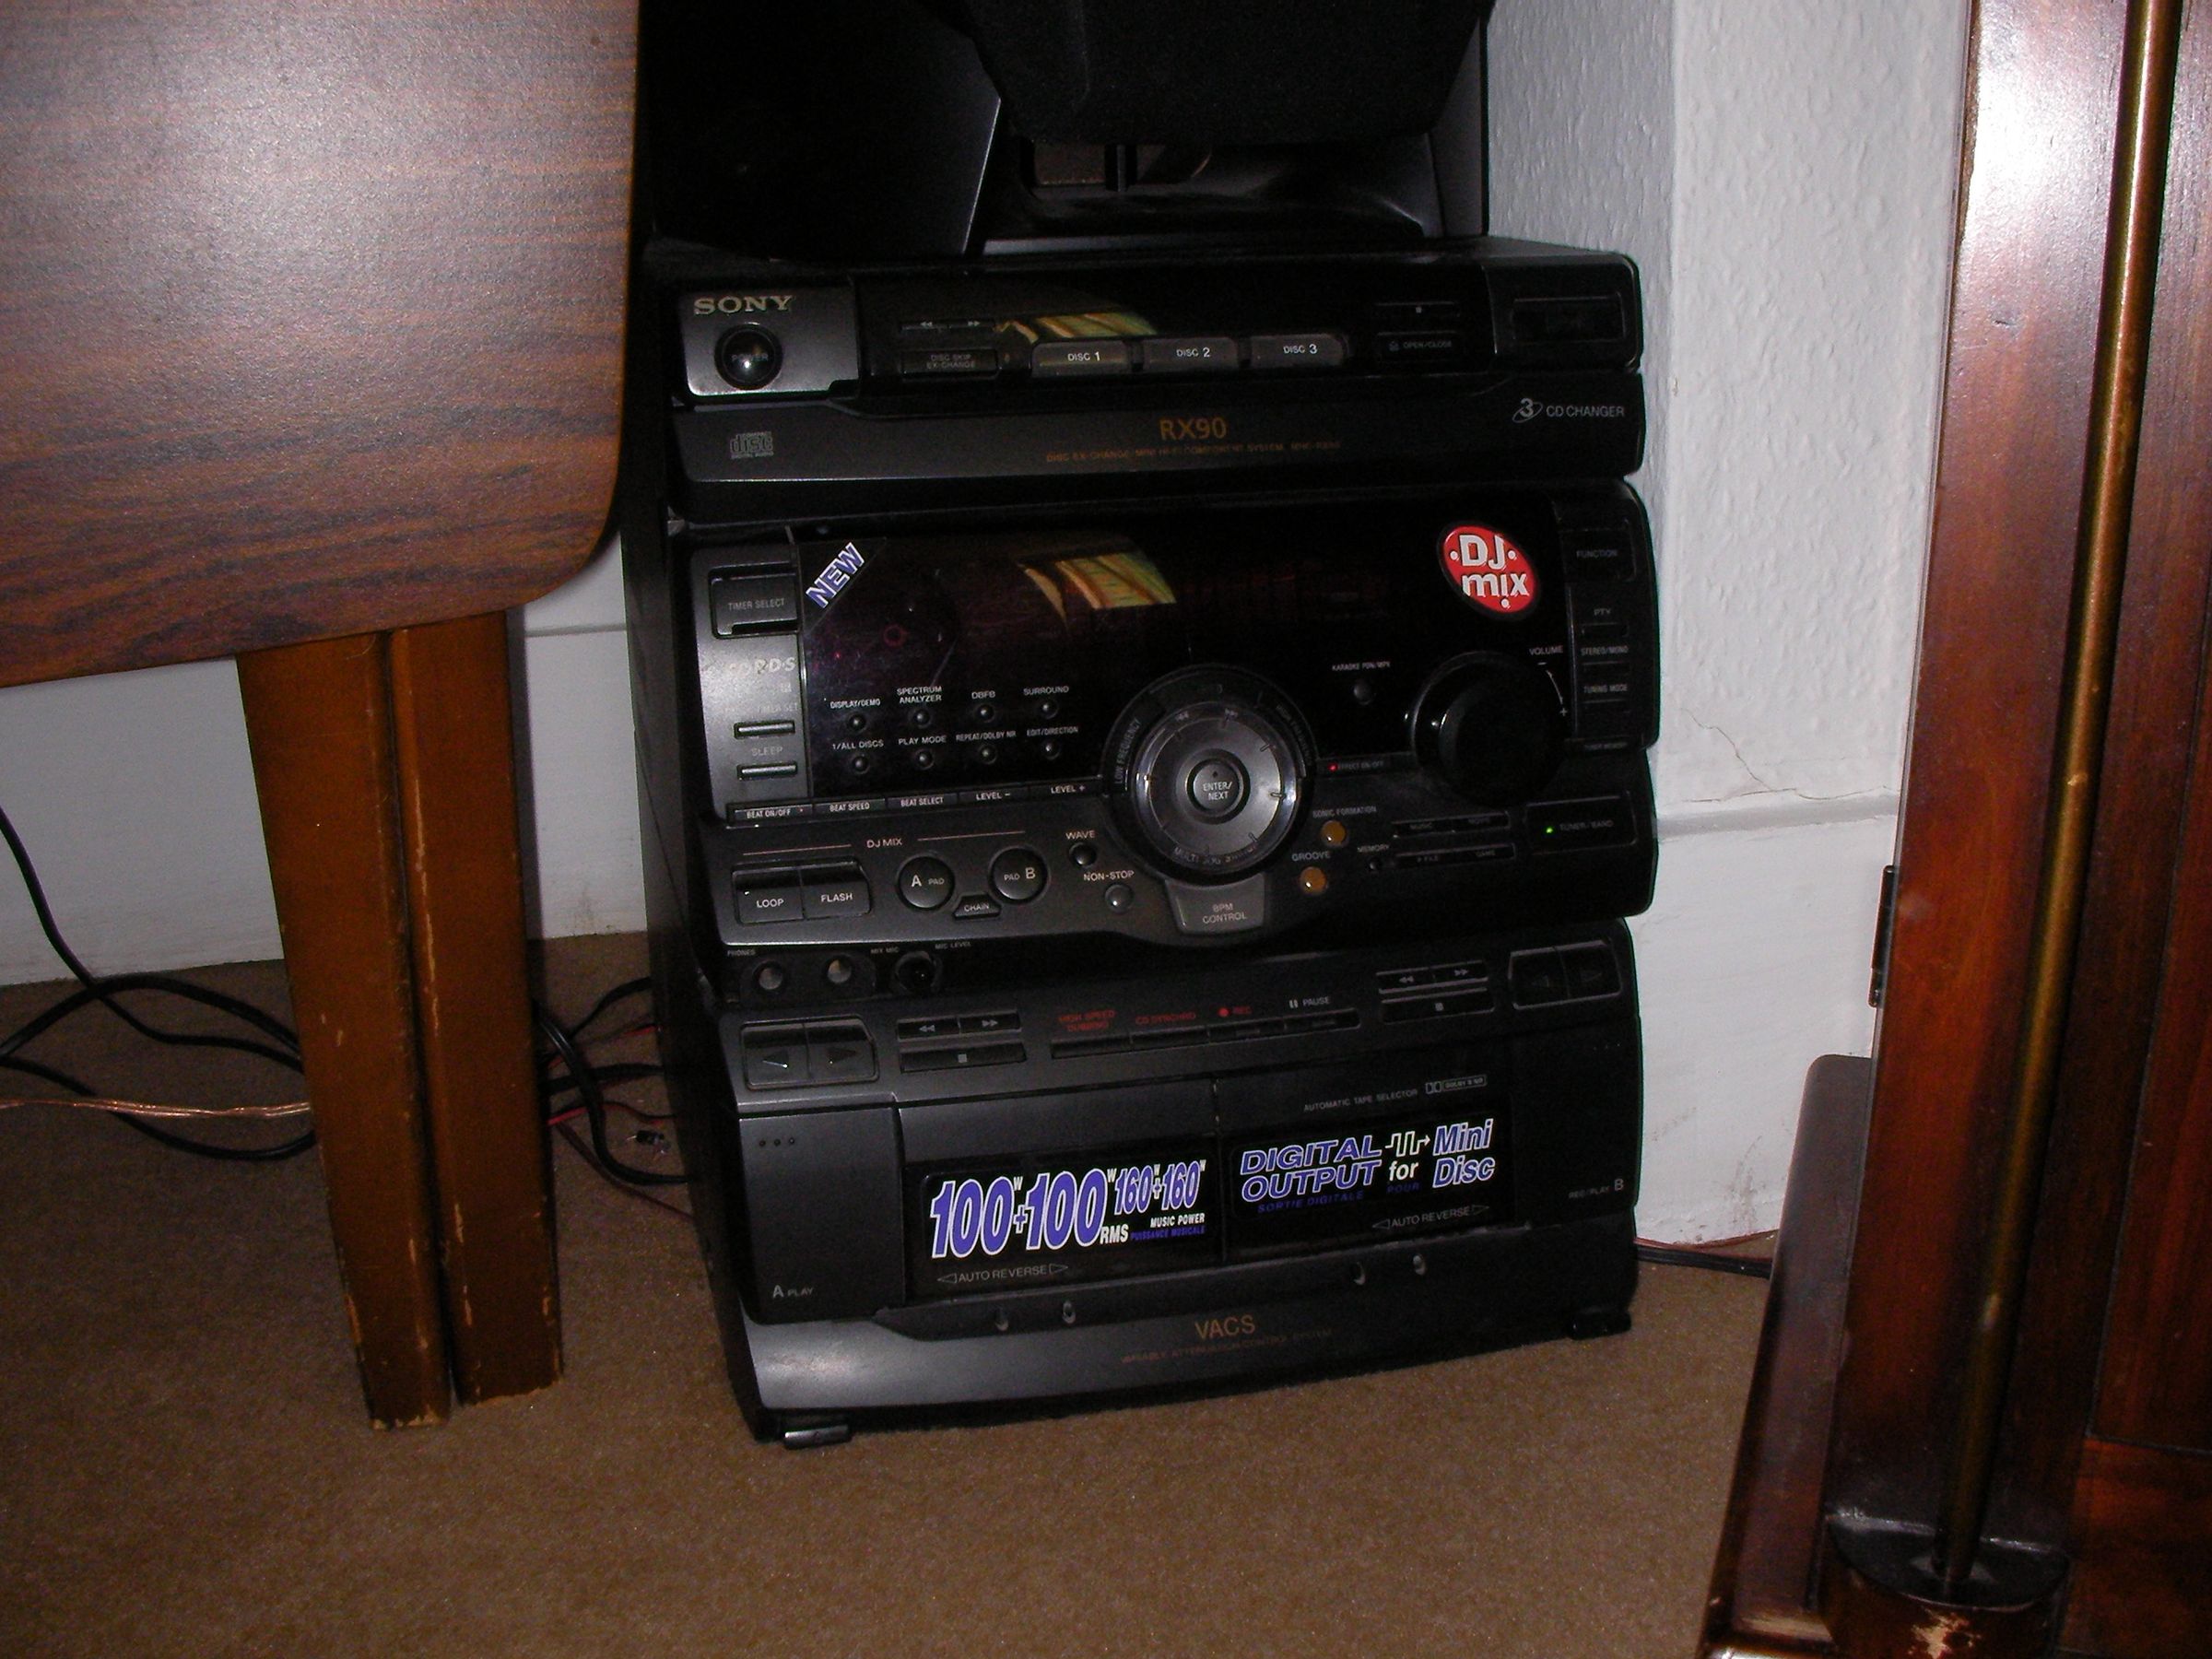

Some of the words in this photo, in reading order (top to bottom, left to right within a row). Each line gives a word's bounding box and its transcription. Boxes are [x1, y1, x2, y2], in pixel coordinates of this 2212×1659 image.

[693, 295, 794, 315] SONY
[1176, 348, 1199, 359] DISC
[1203, 347, 1211, 359] 2
[1282, 345, 1306, 355] DISC
[1309, 343, 1318, 355] 3
[1067, 353, 1091, 362] DISC
[1094, 351, 1101, 362] 1
[1519, 397, 1535, 418] 3
[1546, 405, 1565, 418] CD
[1566, 405, 1626, 418] CHANGER
[1159, 416, 1229, 441] RX90
[1458, 533, 1507, 571] DJ
[1575, 549, 1618, 559] FUNCTION
[805, 541, 866, 609] NEW
[1461, 571, 1530, 609] mix
[728, 601, 753, 611] TIMER
[755, 599, 784, 609] SELECT
[1593, 607, 1612, 617] PTY
[1528, 645, 1564, 656] VOLUME
[896, 686, 943, 696] SPECTRUM
[1023, 685, 1070, 696] SURROUND
[830, 699, 881, 710] DISPLAY/DEMO
[899, 694, 942, 704] ANALYZER
[1026, 725, 1079, 736] EDIT/DIRECTION
[832, 740, 857, 750] 1/ALL
[859, 739, 885, 748] DISCS
[898, 736, 920, 746] PLAY
[922, 735, 947, 745] MODE
[750, 746, 783, 757] SLEEP
[1050, 785, 1077, 794] LEVEL
[975, 792, 1002, 801] LEVEL
[1207, 790, 1229, 801] NEXT
[830, 803, 848, 812] BEAT
[849, 801, 870, 811] SPEED
[900, 798, 918, 807] BEAT
[919, 796, 944, 806] SELECT
[747, 809, 764, 819] BEAT
[765, 808, 792, 818] ON/OFF
[1312, 810, 1335, 819] SONIC
[1335, 806, 1377, 817] FORMATION
[1065, 830, 1096, 840] WAVE
[866, 840, 880, 849] DJ
[882, 838, 903, 847] MIX
[1357, 843, 1390, 853] MEMORY
[1291, 851, 1331, 862] GROOVE
[1003, 873, 1020, 881] PAD
[1025, 866, 1036, 879] B
[1083, 870, 1135, 881] NON-STOP
[911, 875, 923, 888] A
[928, 877, 945, 886] PAD
[756, 898, 784, 909] LOOP
[820, 892, 853, 903] FLASH
[963, 903, 990, 913] CHAIN
[1211, 904, 1234, 913] BPM
[1202, 912, 1247, 924] CONTROL
[949, 941, 971, 949] LEVEL
[726, 948, 756, 958] PHONES
[1301, 995, 1331, 1006] PAUSE
[1303, 1099, 1351, 1112] AUTOMATIC
[1353, 1095, 1374, 1105] TAPE
[1376, 1088, 1418, 1102] SELECTOR
[1240, 1135, 1383, 1175] DIGITAL
[1432, 1117, 1494, 1157] Mini
[1241, 1159, 1383, 1203] OUTPUT
[1388, 1159, 1419, 1182] for
[1432, 1154, 1496, 1189] Disc
[1614, 1178, 1624, 1192] B
[1149, 1216, 1176, 1229] MUSIC
[1177, 1212, 1206, 1225] POWER
[1390, 1213, 1421, 1229] AUTO
[1421, 1206, 1473, 1223] REVERSE
[1099, 1224, 1130, 1245] RMS
[958, 1268, 991, 1284] AUTO
[992, 1264, 1048, 1280] REVERSE
[771, 1284, 784, 1299] A
[787, 1286, 814, 1297] PLAY
[1194, 1313, 1256, 1340] VACS
